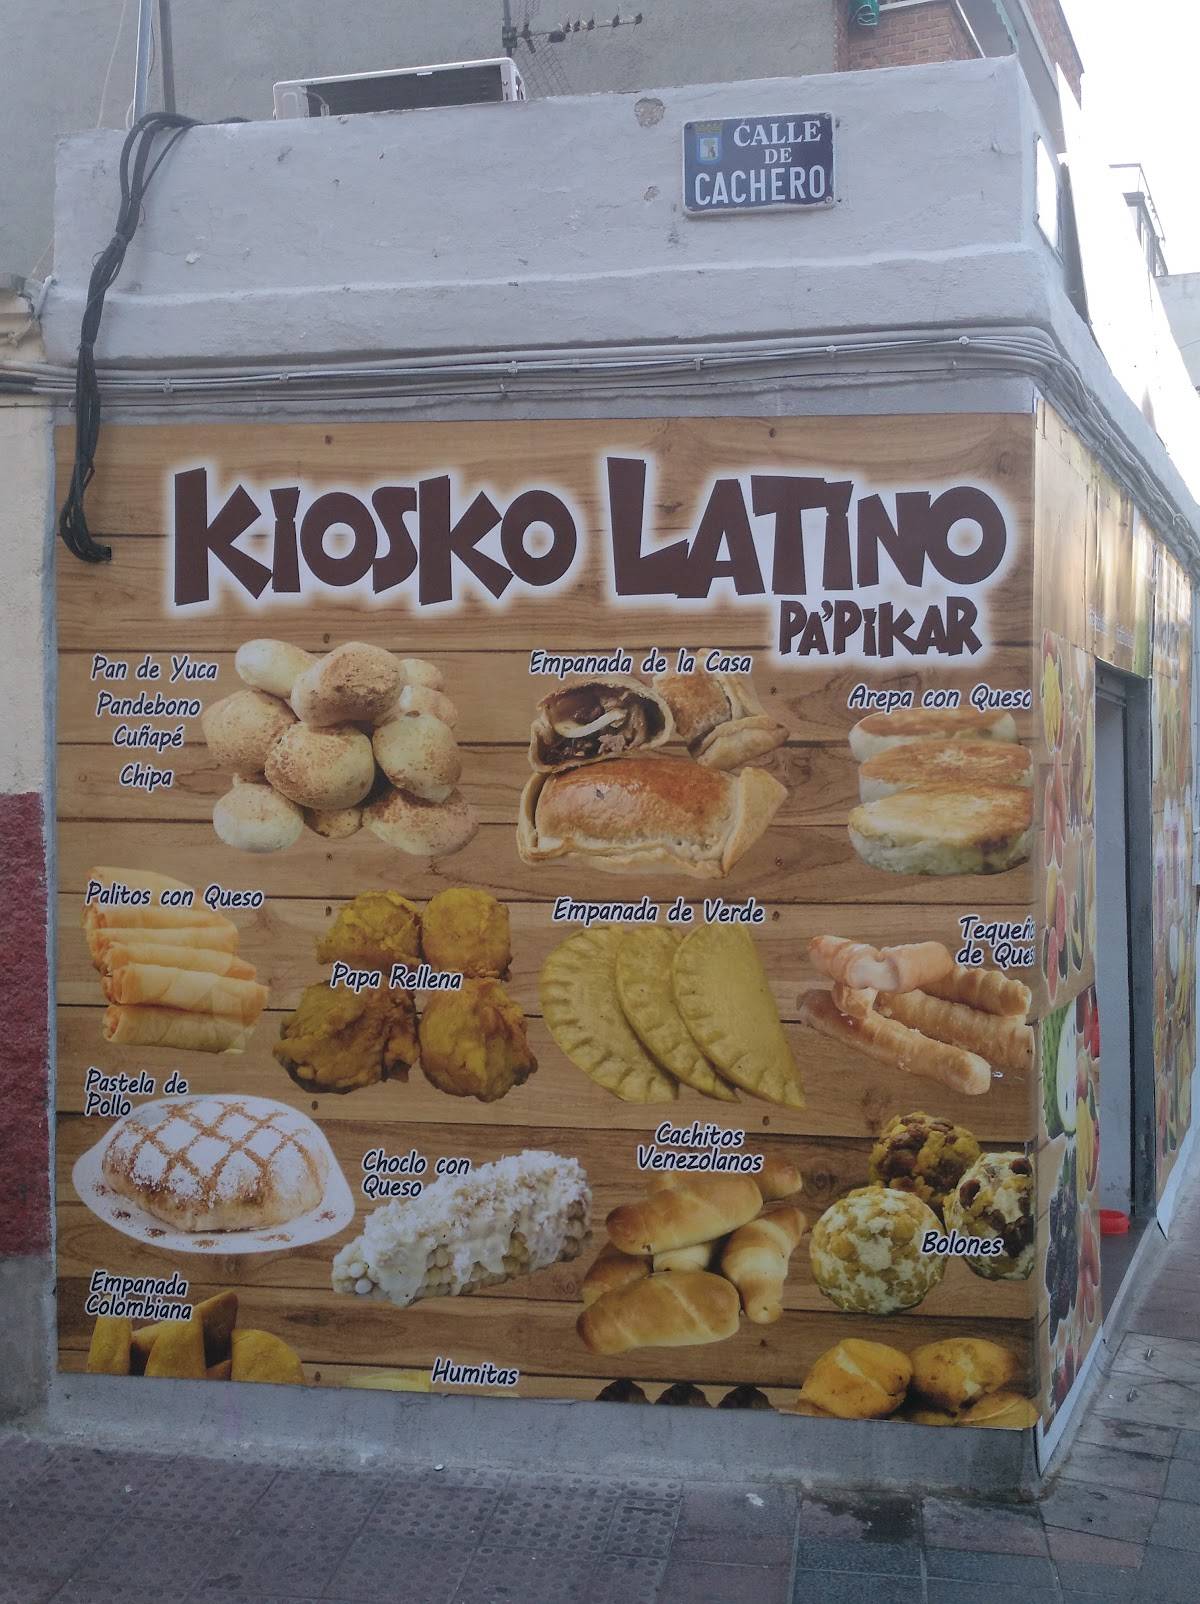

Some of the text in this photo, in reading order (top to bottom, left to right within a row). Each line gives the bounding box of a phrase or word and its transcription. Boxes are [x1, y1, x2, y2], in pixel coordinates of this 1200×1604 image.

[733, 120, 822, 147] CALLE
[764, 147, 792, 164] DE
[694, 164, 826, 206] CACHERO
[174, 456, 1007, 606] KIOSKO LATINO
[91, 654, 218, 682] Pan de Yuca
[529, 648, 752, 679] Empanada de la Casa
[96, 690, 202, 716] Pandebono
[848, 683, 913, 714] Arepa
[923, 690, 960, 708] con
[113, 723, 184, 753] Cuñapé
[120, 762, 173, 792] Chipa
[85, 880, 264, 910] Palitos con Queso
[552, 897, 765, 926] Empanada de Verde
[957, 939, 983, 964] de
[330, 961, 462, 993] Papa Rellena
[85, 1067, 188, 1094] Pastela de
[85, 1091, 132, 1117] Pollo
[656, 1121, 744, 1147] Cachitos
[362, 1149, 471, 1176] Choclo con
[638, 1145, 763, 1173] Venezolanos
[362, 1173, 423, 1199] Queso
[921, 1230, 1003, 1256] Bolones
[90, 1270, 188, 1298] Empanada
[86, 1293, 193, 1321] Colombiana
[431, 1357, 519, 1386] Humitas
